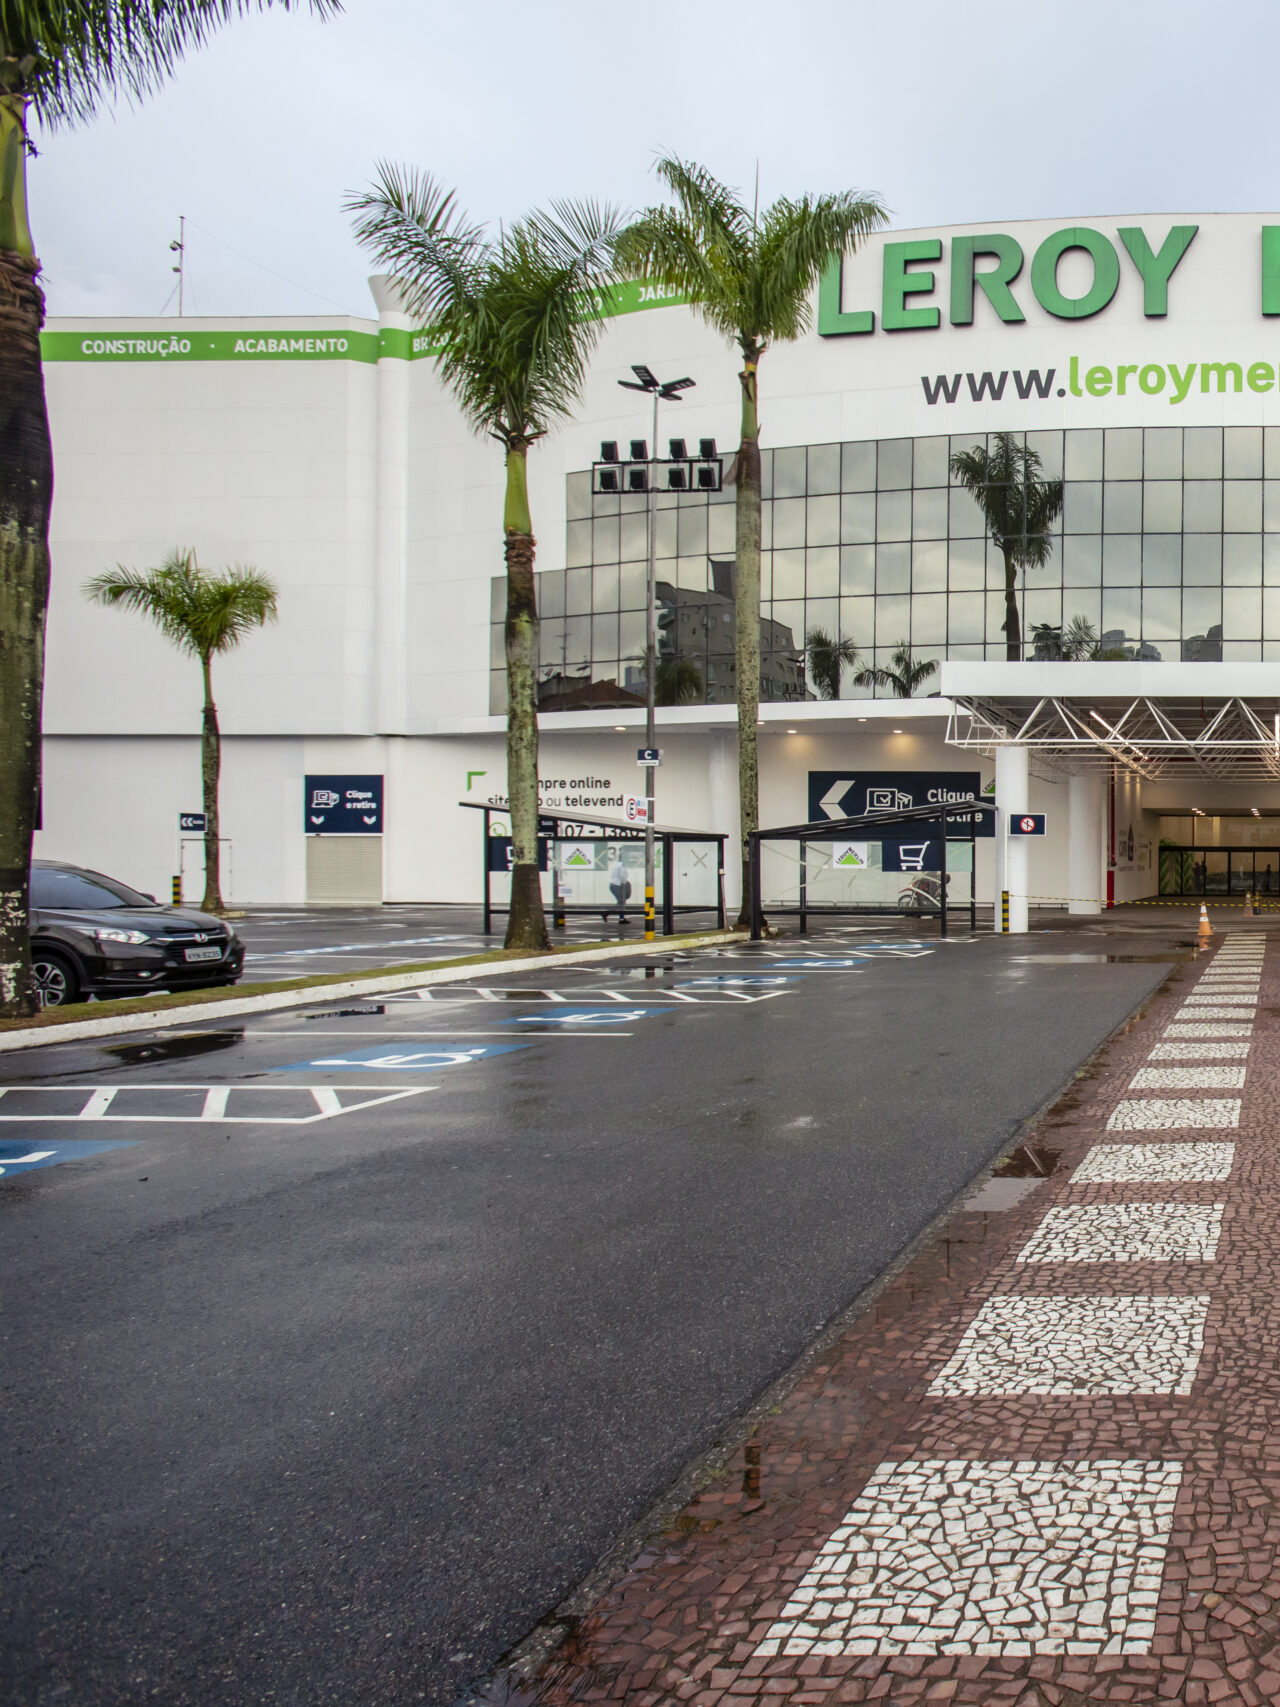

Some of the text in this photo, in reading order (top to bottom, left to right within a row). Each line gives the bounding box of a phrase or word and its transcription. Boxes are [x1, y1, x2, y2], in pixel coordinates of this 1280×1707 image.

[818, 224, 1200, 337] LEROY
[81, 336, 348, 358] CONSTRUÇÃO ACABAMENTO
[569, 777, 611, 789] online
